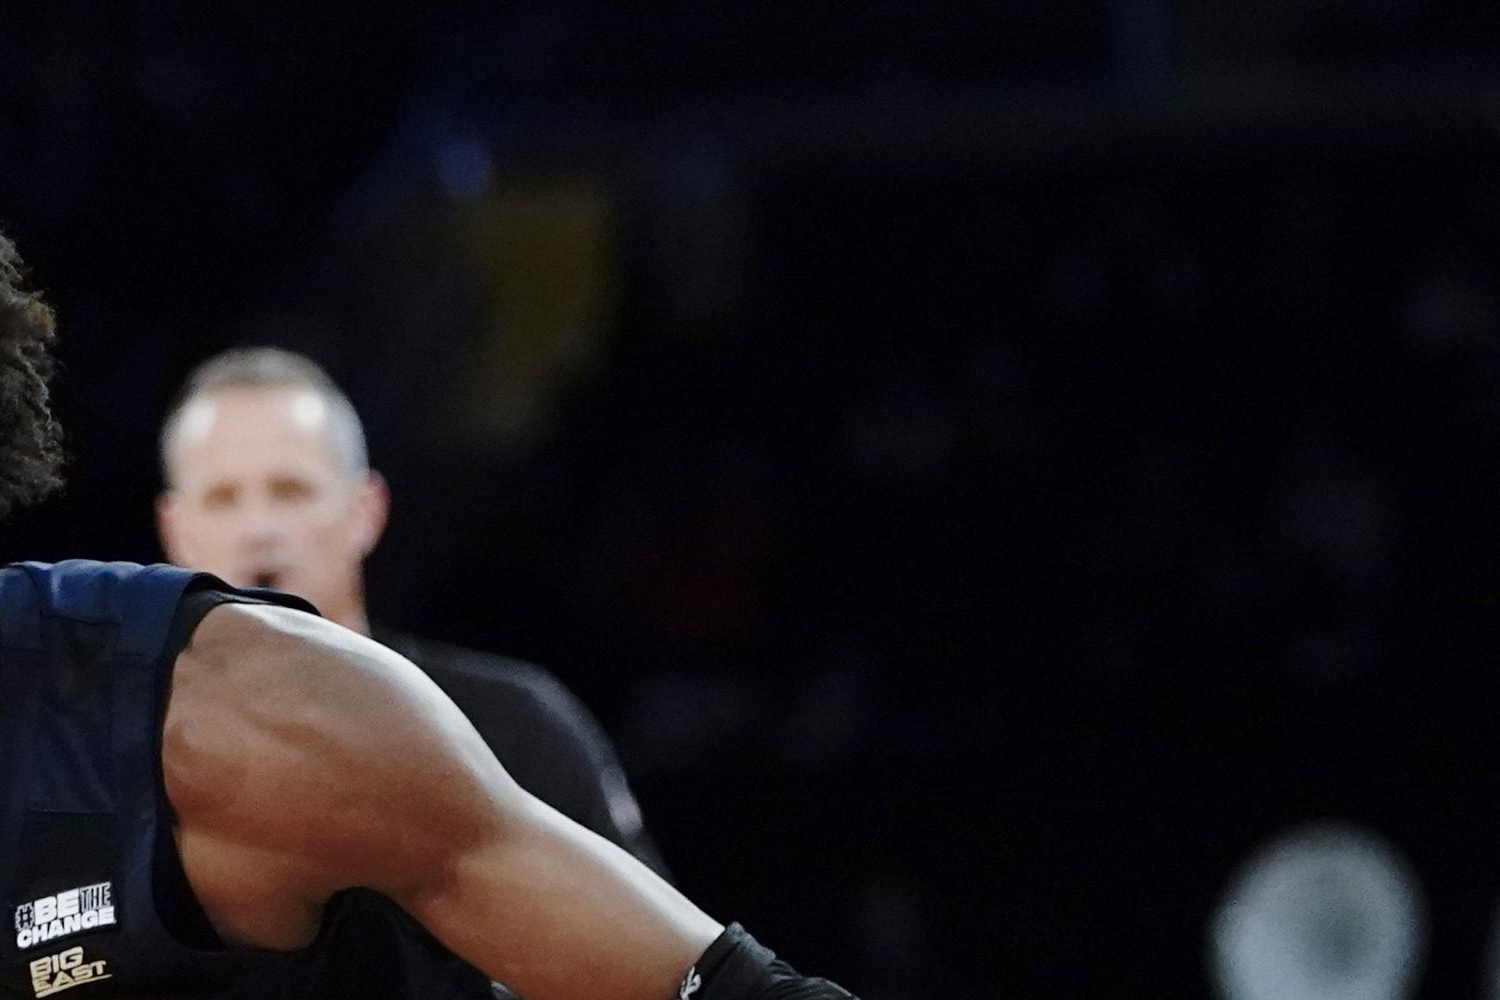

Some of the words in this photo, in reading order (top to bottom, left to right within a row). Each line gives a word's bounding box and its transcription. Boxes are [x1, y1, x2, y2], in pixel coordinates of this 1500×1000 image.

[16, 905, 117, 949] CHANGE
[30, 946, 84, 978] BIG
[32, 960, 107, 994] EAST
